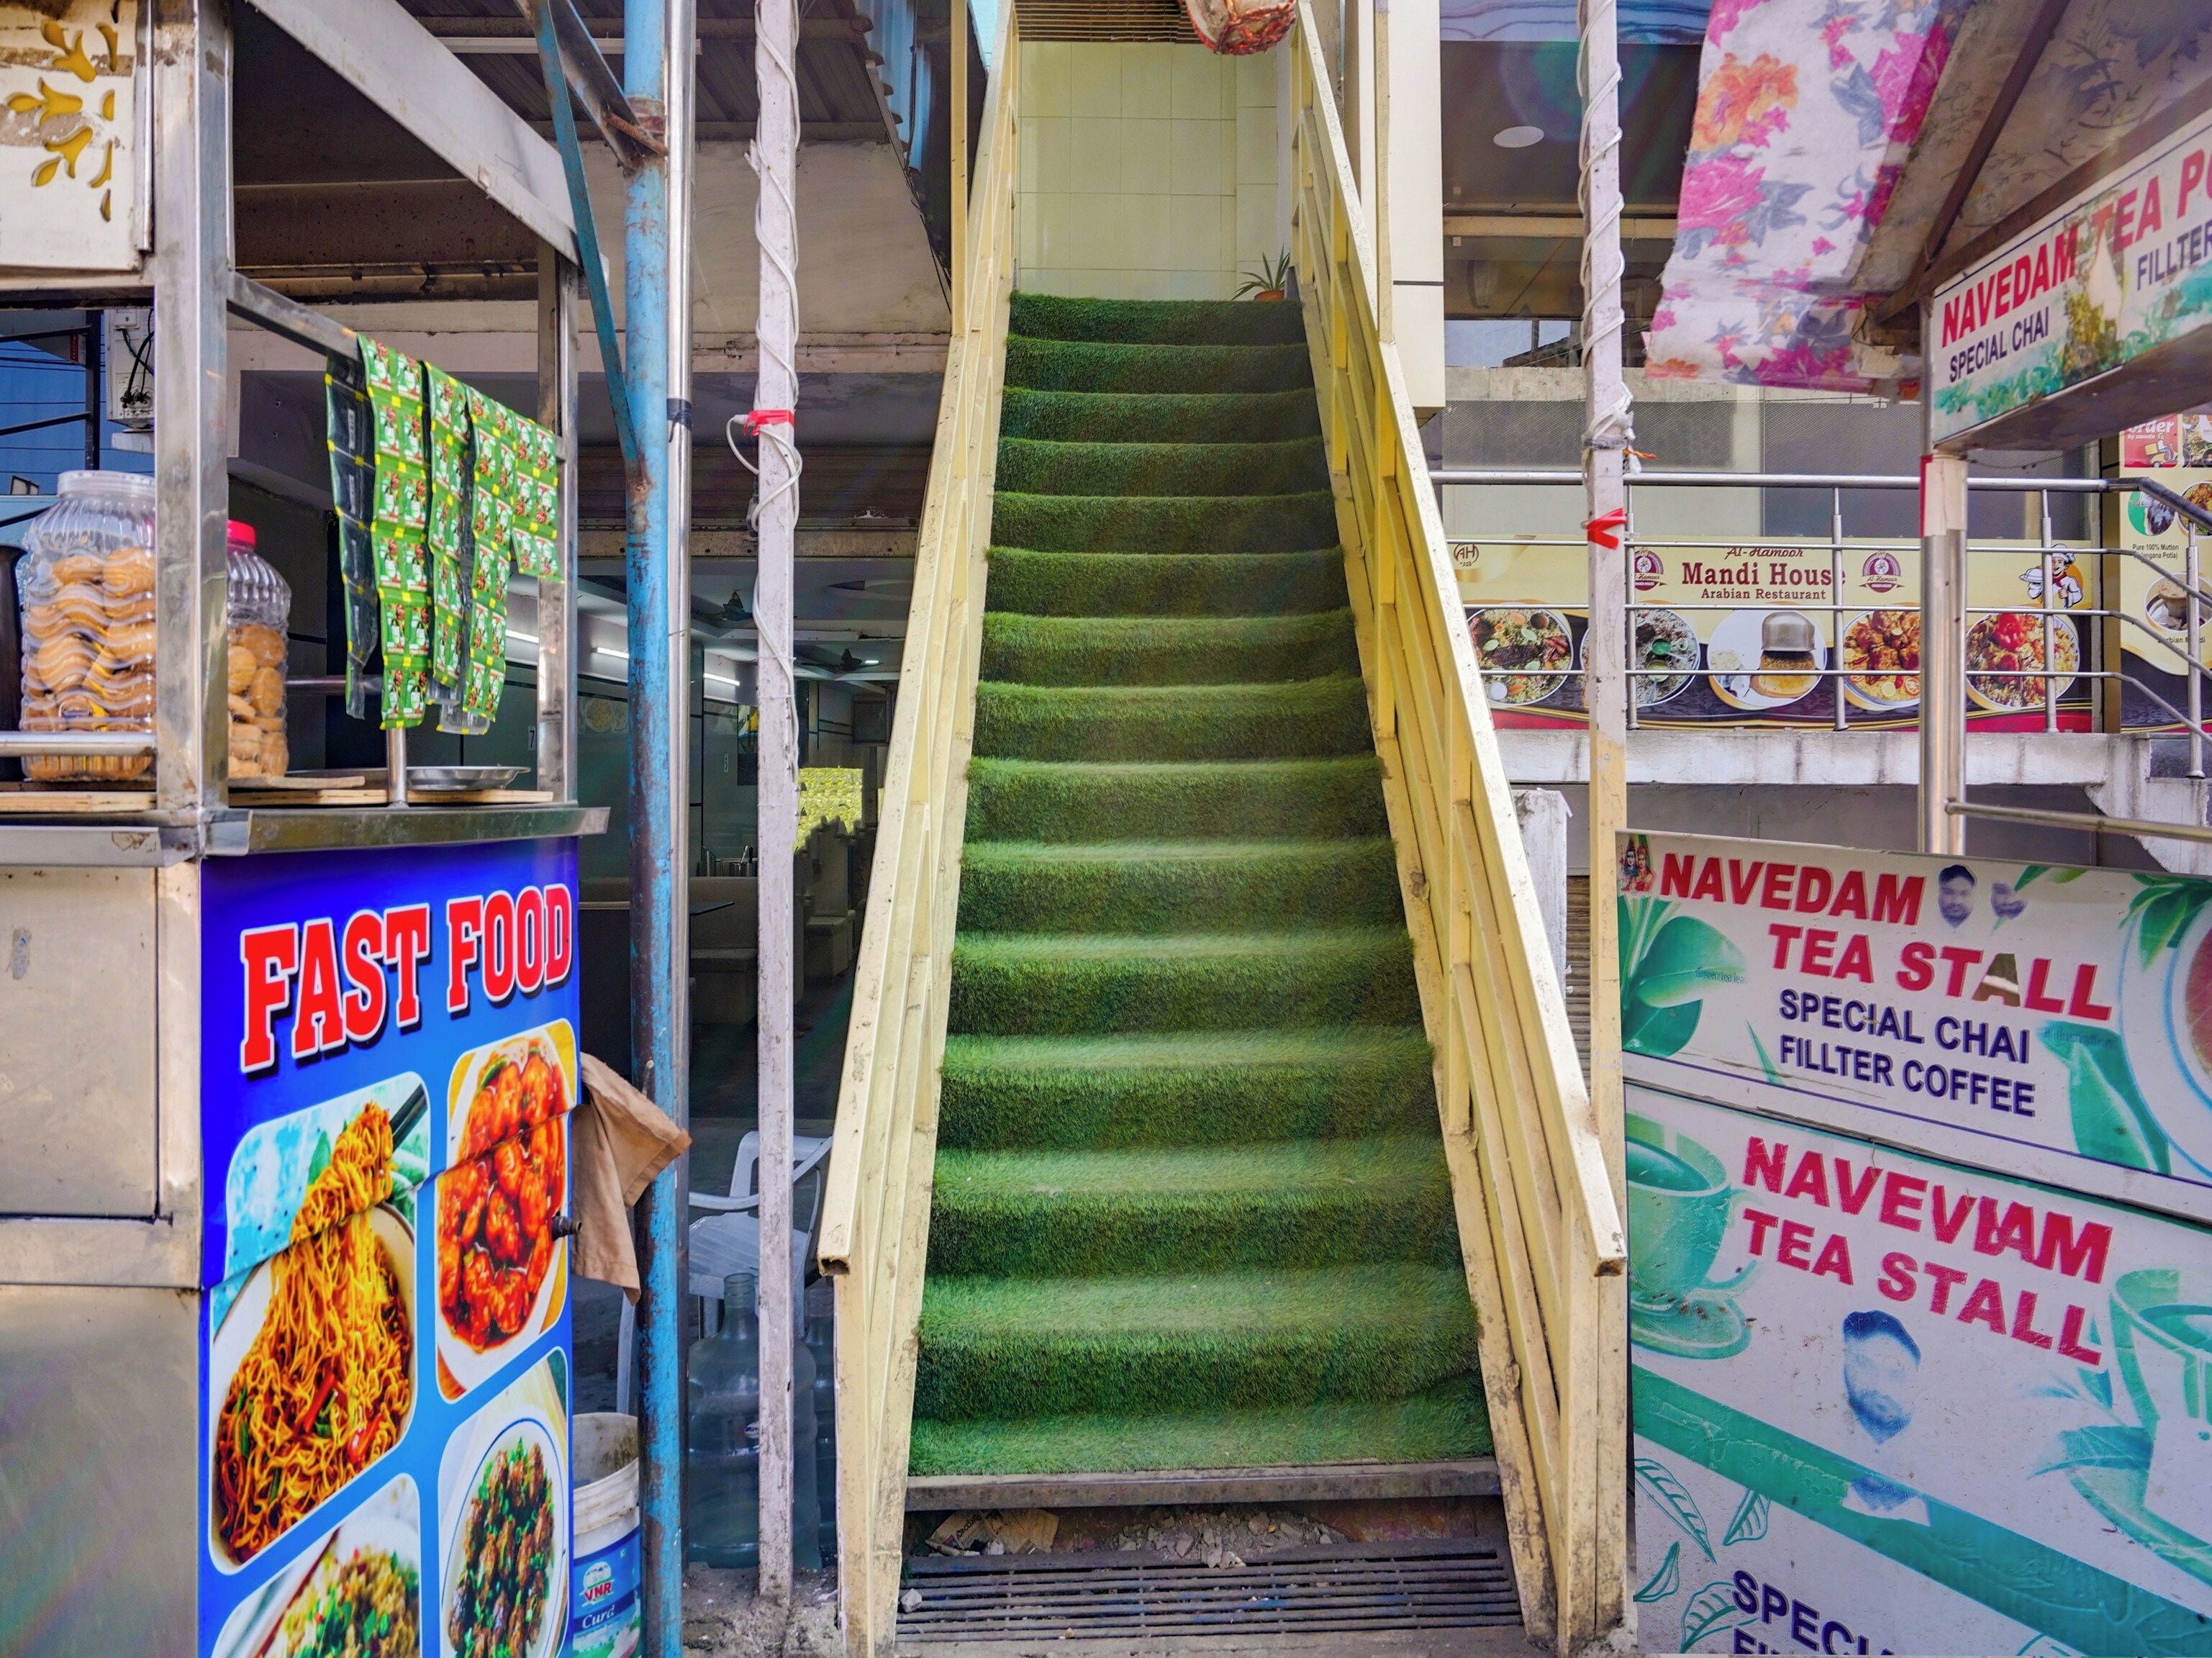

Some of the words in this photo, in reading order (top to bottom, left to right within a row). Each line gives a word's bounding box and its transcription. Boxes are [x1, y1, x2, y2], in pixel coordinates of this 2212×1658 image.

[1941, 225, 2078, 348] NAVEDAM
[2090, 175, 2162, 255] TEA
[1949, 331, 2008, 383] SPECIAL
[2012, 306, 2049, 352] CHAI
[1682, 561, 1759, 585] Mandi
[1769, 562, 1846, 586] Hous
[1701, 588, 1751, 599] Arabian
[1755, 589, 1826, 600] Restaurant
[1661, 853, 1927, 927] NAVEDAM
[240, 902, 430, 1074] FAST
[446, 883, 573, 1013] FOOD
[1768, 923, 1875, 984] TEA
[1895, 942, 2113, 1022] STALL
[1780, 988, 1925, 1044] SPECIAL
[1935, 1015, 2031, 1064] CHAI
[1780, 1033, 1895, 1087] FILLTER
[1902, 1059, 2036, 1118] COFFEE
[1742, 1208, 1854, 1286] TEA
[1877, 1251, 2102, 1367] STALL
[581, 1604, 615, 1628] Curd
[584, 1581, 612, 1601] VNR
